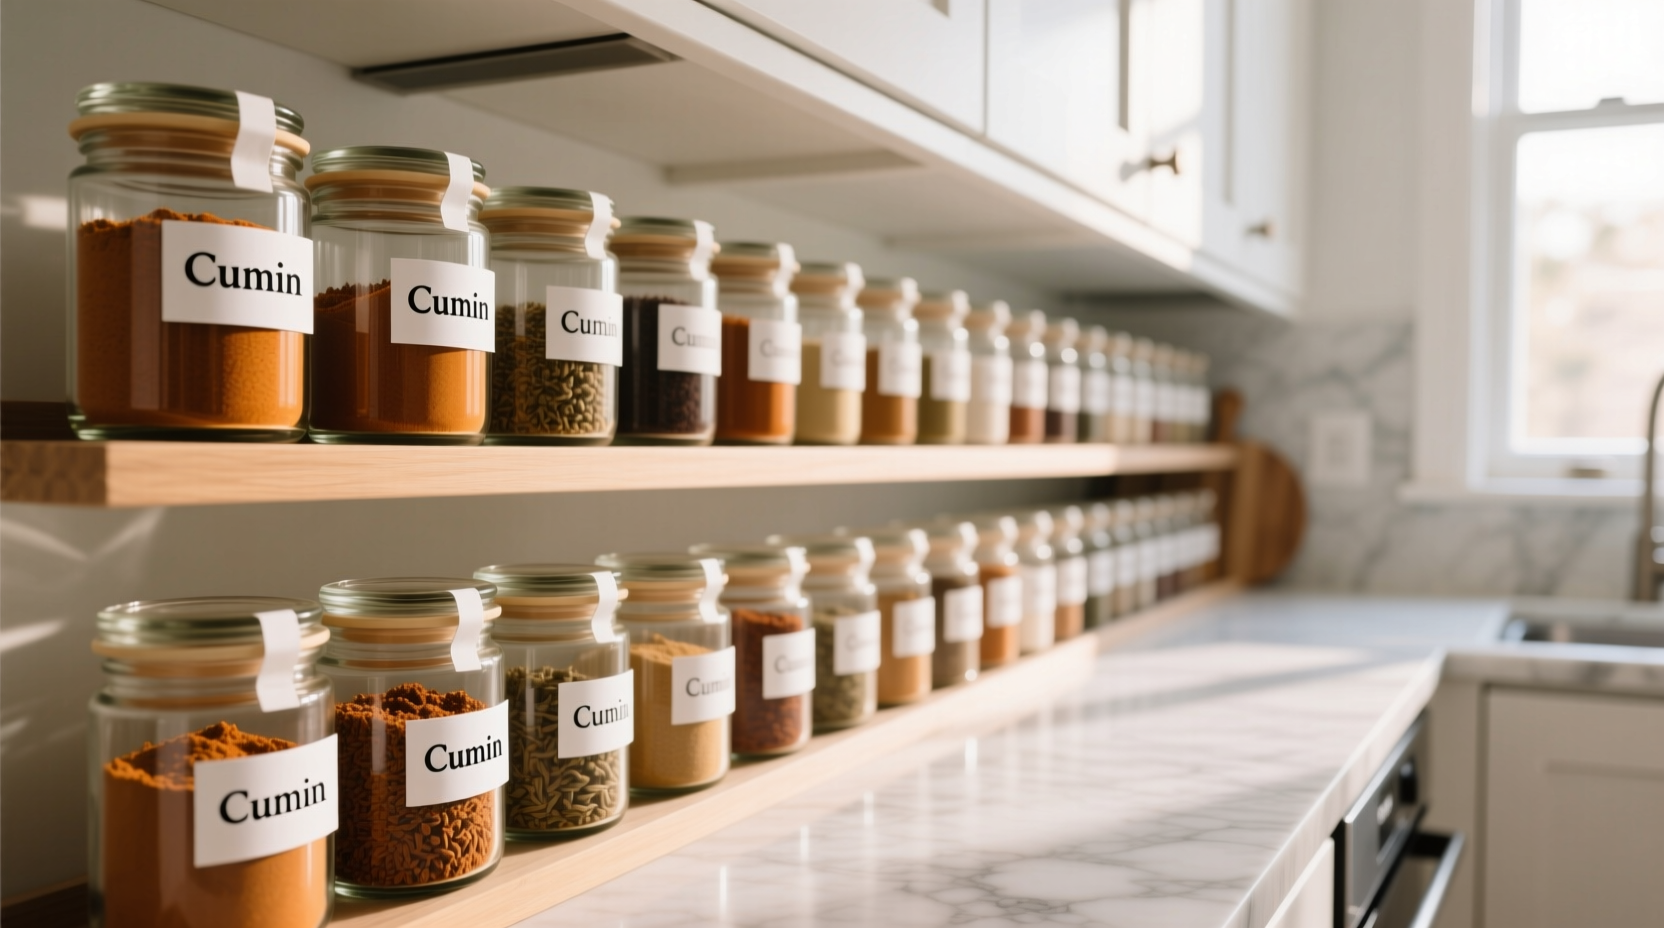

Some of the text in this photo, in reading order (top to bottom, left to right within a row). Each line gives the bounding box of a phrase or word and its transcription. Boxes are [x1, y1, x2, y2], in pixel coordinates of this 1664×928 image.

[184, 251, 302, 296] Cumin
[407, 285, 489, 321] Cumin
[573, 699, 628, 728] Cumin
[424, 735, 502, 772] Cumin
[219, 778, 326, 823] Cumin
